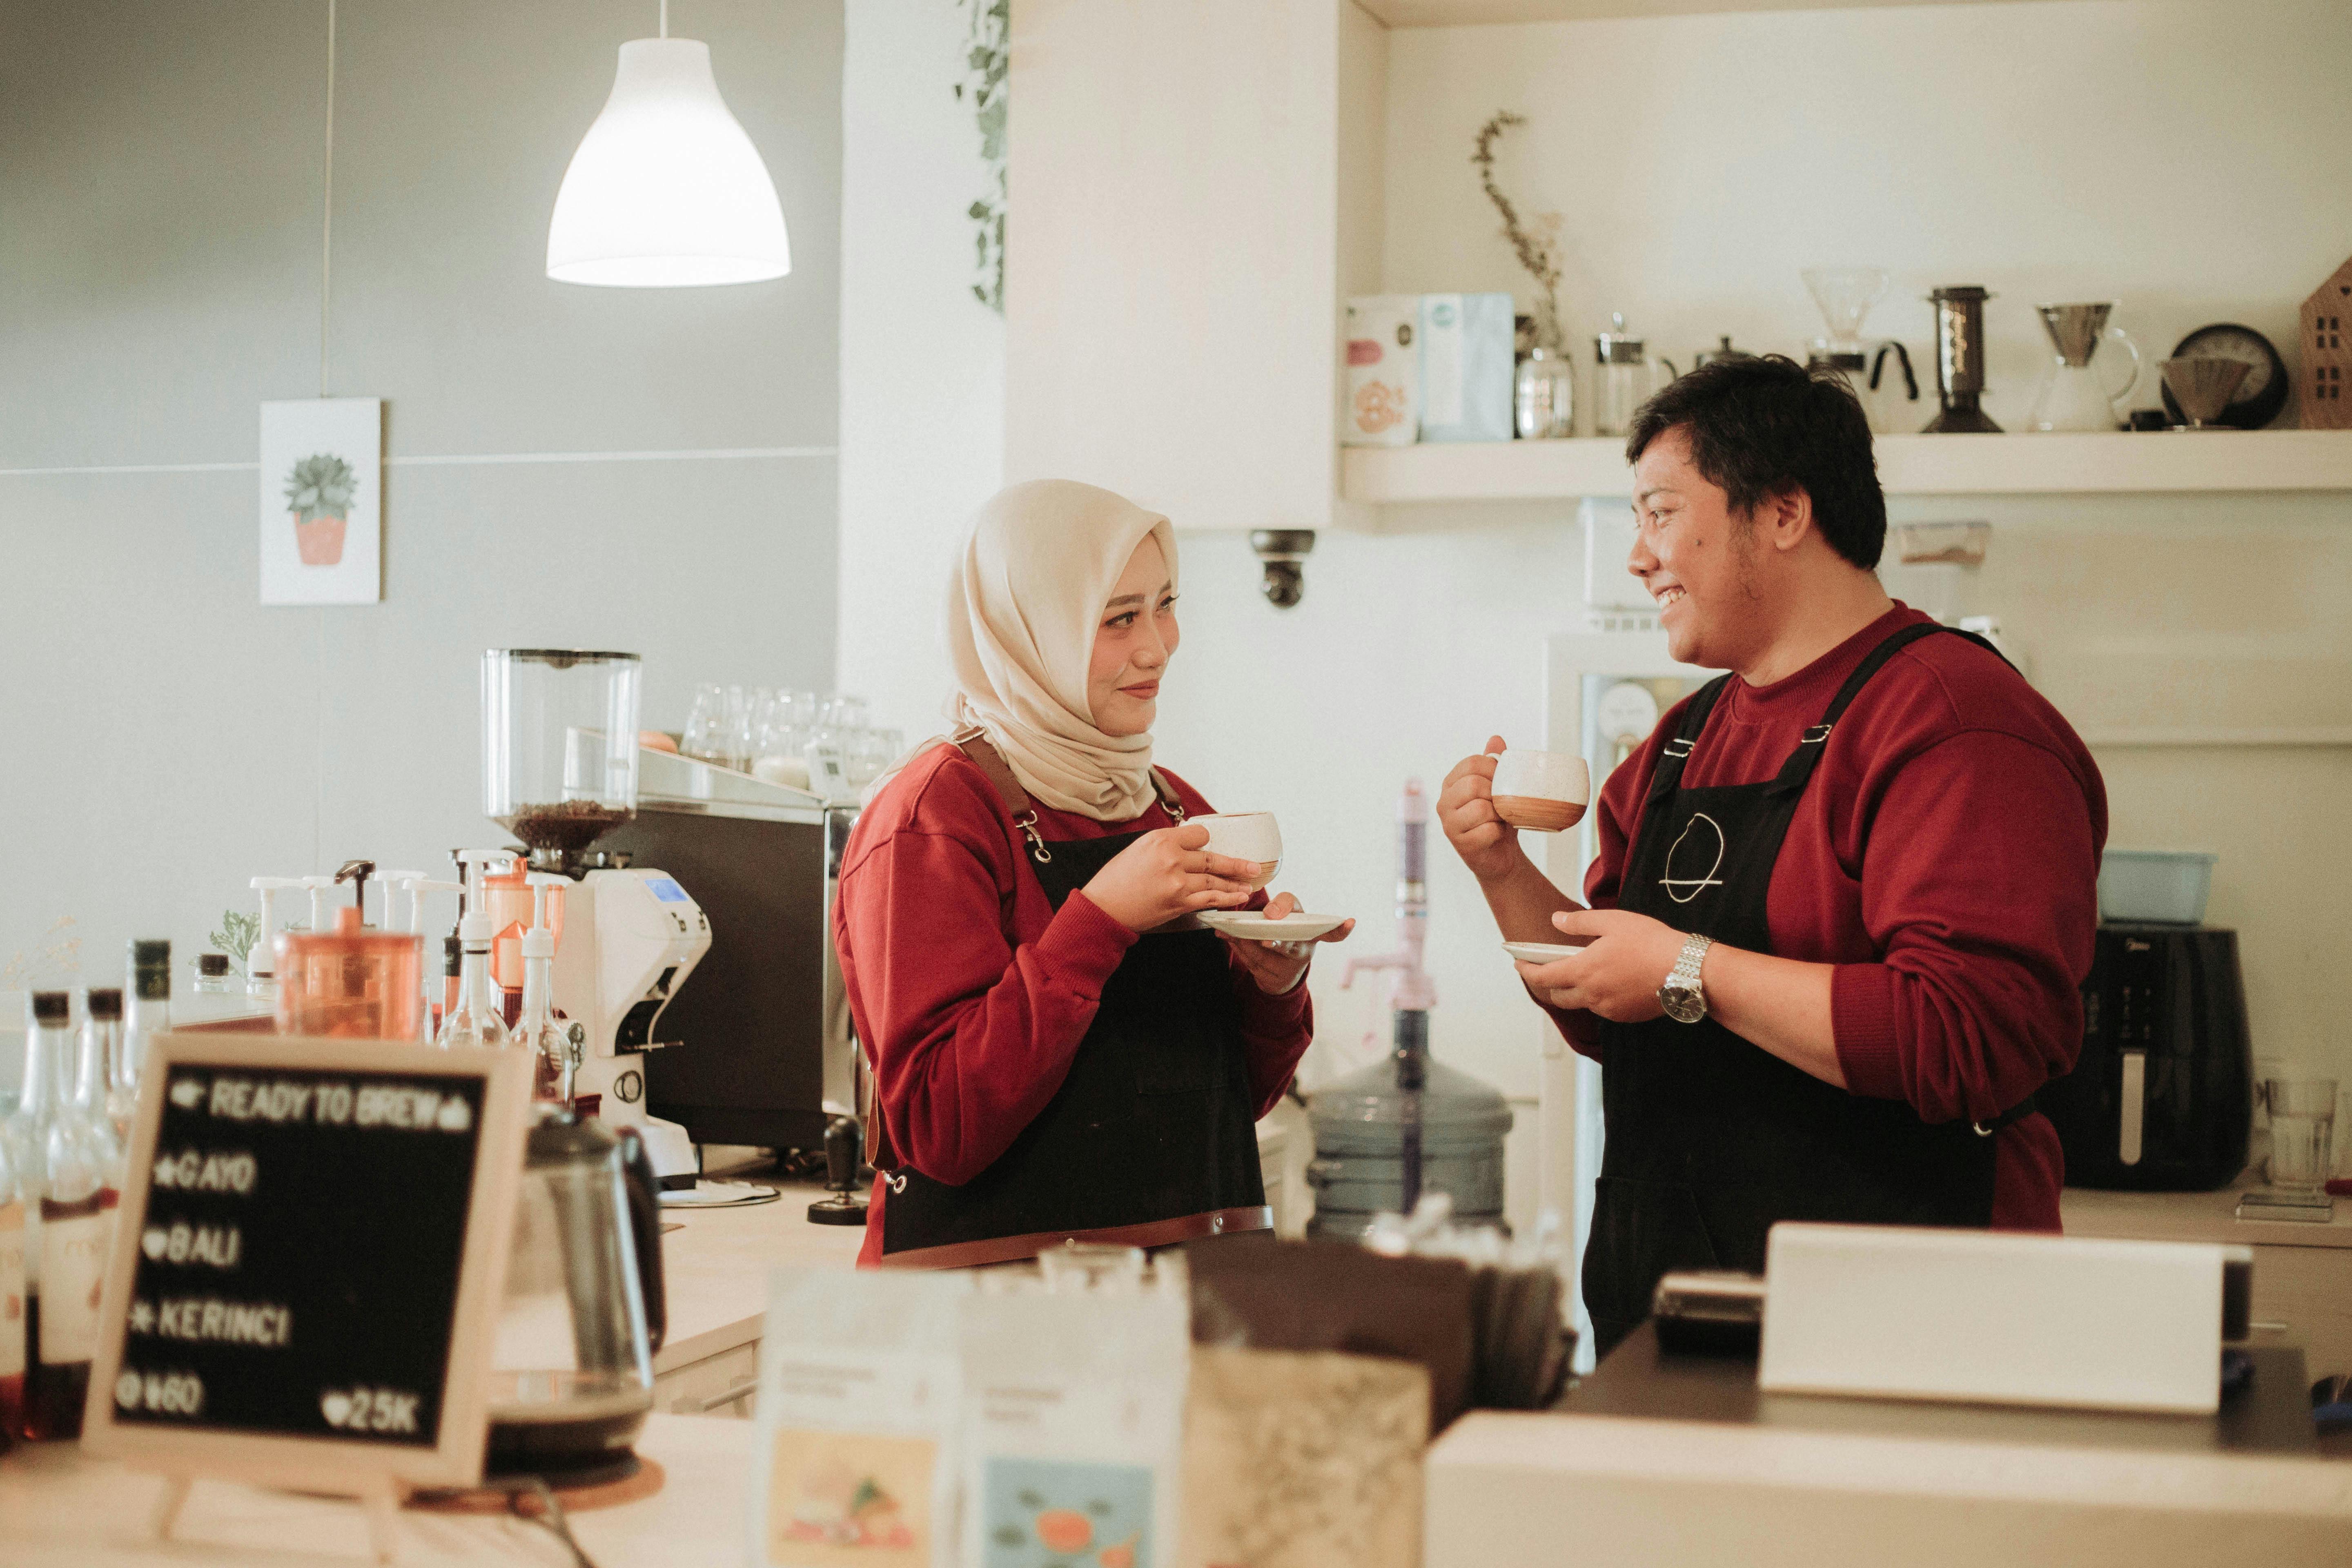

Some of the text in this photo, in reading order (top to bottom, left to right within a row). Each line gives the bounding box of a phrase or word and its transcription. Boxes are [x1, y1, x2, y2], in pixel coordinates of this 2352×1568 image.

[210, 1079, 441, 1130] READY TO BREW
[176, 1151, 257, 1192] GAYO
[167, 1222, 240, 1265] BALI
[158, 1299, 291, 1347] KERINCI
[347, 1388, 419, 1432] 25K
